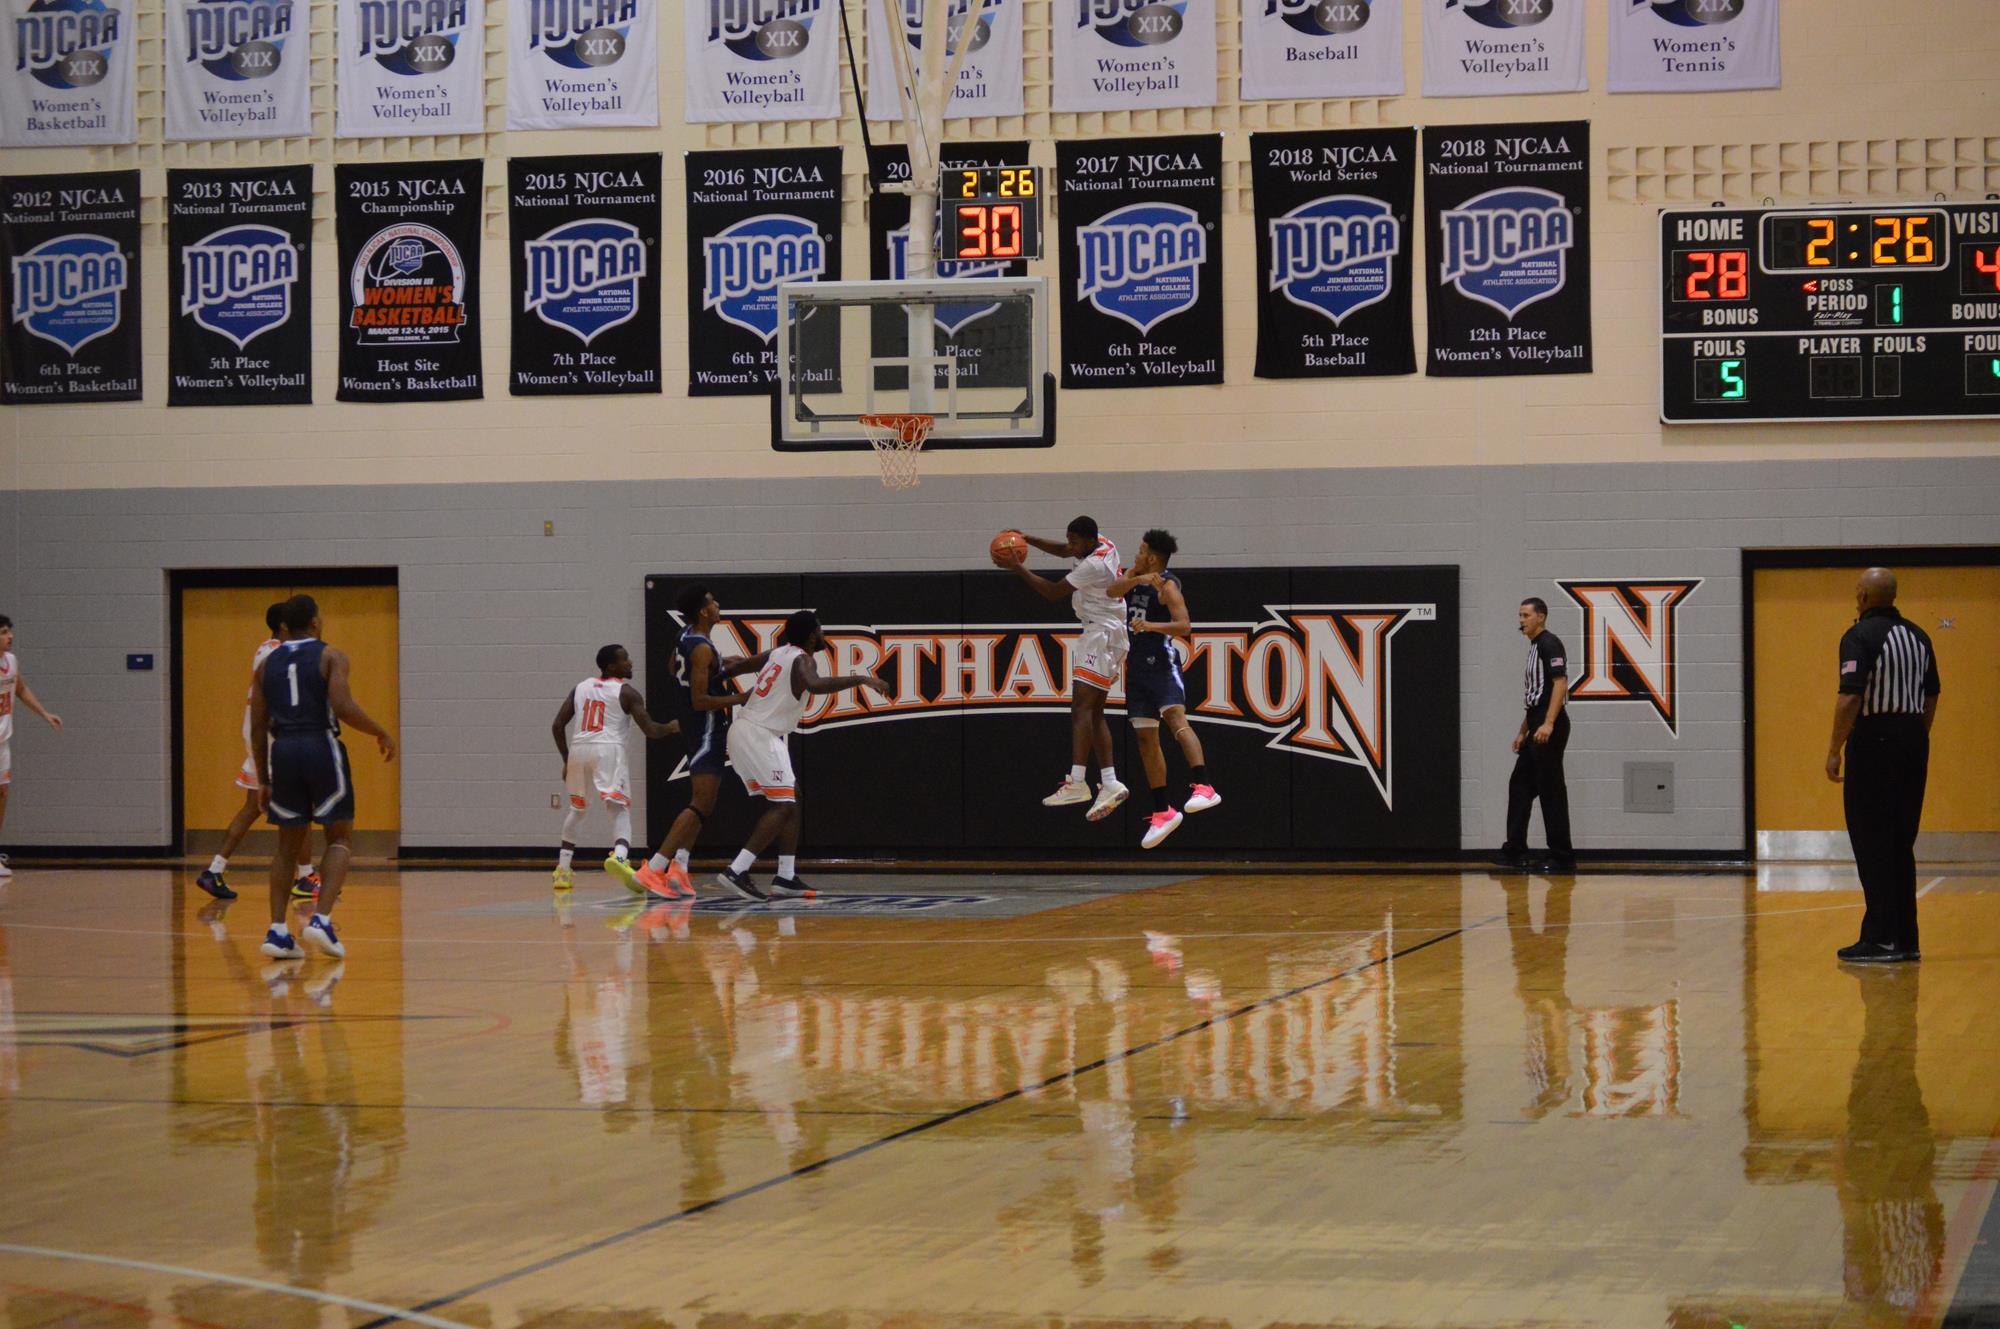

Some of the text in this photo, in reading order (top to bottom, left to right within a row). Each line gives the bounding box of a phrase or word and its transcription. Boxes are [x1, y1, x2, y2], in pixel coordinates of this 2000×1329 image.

[1325, 4, 1360, 22] XIX
[1507, 0, 1543, 14] XIX
[359, 0, 466, 57] NJCAA
[1138, 15, 1173, 33] XIX
[15, 12, 119, 71] NJCAA
[185, 4, 292, 63] NJCAA
[766, 30, 799, 47] XIX
[584, 39, 618, 56] XIX
[1465, 37, 1545, 54] Women's
[1652, 36, 1735, 52] Women's
[240, 51, 273, 67] XIX
[413, 45, 447, 62] XIX
[1286, 45, 1358, 61] Baseball
[68, 59, 100, 76] XIX
[1097, 56, 1175, 73] Women's
[1461, 57, 1549, 78] Volleyball
[1662, 56, 1725, 72] Tennis
[545, 78, 618, 93] Women's
[726, 70, 801, 85] Women's
[1092, 75, 1179, 96] Volleyball
[203, 89, 274, 104] Women's
[376, 84, 448, 100] Women's
[722, 88, 804, 108] Volleyball
[32, 98, 102, 112] Women's
[372, 102, 451, 122] Volleyball
[542, 96, 622, 116] Volleyball
[27, 115, 107, 130] Basketball
[199, 106, 277, 126] Volleyball
[1269, 145, 1398, 169] 2018 NJCAA
[1441, 136, 1571, 161] 2018 NJCAA
[1076, 153, 1202, 176] 2017 NJCAA
[1429, 160, 1583, 175] National Tournament
[525, 171, 645, 193] 2015 NJCAA
[703, 166, 824, 189] 2016 NJCAA
[1065, 176, 1215, 191] National Tournament
[1290, 168, 1378, 182] World Series
[183, 180, 296, 202] 2013 NJCAA
[350, 178, 466, 200] 2015 NJCAA
[693, 189, 835, 203] National Tournament
[12, 188, 124, 210] 2012 NJCAA
[514, 193, 656, 207] National Tournament
[3, 209, 136, 224] National Tournament
[173, 201, 307, 215] National Tournament
[361, 200, 455, 217] Championship
[959, 205, 1020, 258] 30
[1677, 218, 1743, 241] HOME
[1443, 210, 1571, 281] NJCAA
[1807, 216, 1933, 266] 2:26
[390, 246, 424, 264] NJCAA
[1080, 225, 1203, 296] NJCAA
[1272, 217, 1397, 287] NJCAA
[185, 245, 296, 312] NJCAA
[527, 241, 644, 306] NJCAA
[706, 236, 823, 305] NJCAA
[1349, 267, 1383, 275] NATIONAL
[1686, 251, 1747, 299] 28
[14, 254, 126, 319] NJCAA
[384, 279, 420, 287] DIVISION
[1311, 284, 1383, 293] ATHLETIC ASSOCIATION
[1483, 277, 1557, 286] ATHLETIC ASSOCIATION
[1820, 279, 1853, 291] POSS
[364, 285, 454, 305] WOMEN'S
[1807, 294, 1868, 311] PERIOD
[1892, 286, 1900, 323] 1
[354, 305, 465, 326] BASKETBALL
[1703, 308, 1758, 326] BONUS
[428, 326, 449, 334] 2015
[1469, 327, 1547, 342] 12th Place
[1301, 333, 1369, 347] 5th Place
[1693, 340, 1746, 357] FOULS
[1799, 336, 1926, 354] PLAYER FOULS
[945, 345, 982, 357] Place
[1108, 342, 1177, 357] 6th Place
[1435, 345, 1583, 363] Women's Volleyball
[209, 356, 270, 370] 5th Place
[377, 359, 440, 372] Host Site
[553, 352, 616, 366] 7th Place
[732, 352, 754, 365] 6th
[1305, 352, 1366, 366] Baseball
[40, 362, 101, 376] 6th Place
[696, 371, 758, 384] Women's
[1070, 360, 1216, 378] Women's Volleyball
[5, 379, 137, 395] Women's Basketball
[175, 373, 305, 391] Women's Volleyball
[343, 375, 477, 390] Women's Basketball
[518, 370, 654, 387] Women's Volleyball
[1721, 361, 1744, 398] 5
[1417, 608, 1432, 616] TM
[1557, 579, 1700, 730] N
[287, 663, 299, 706] 1
[582, 699, 606, 732] 10
